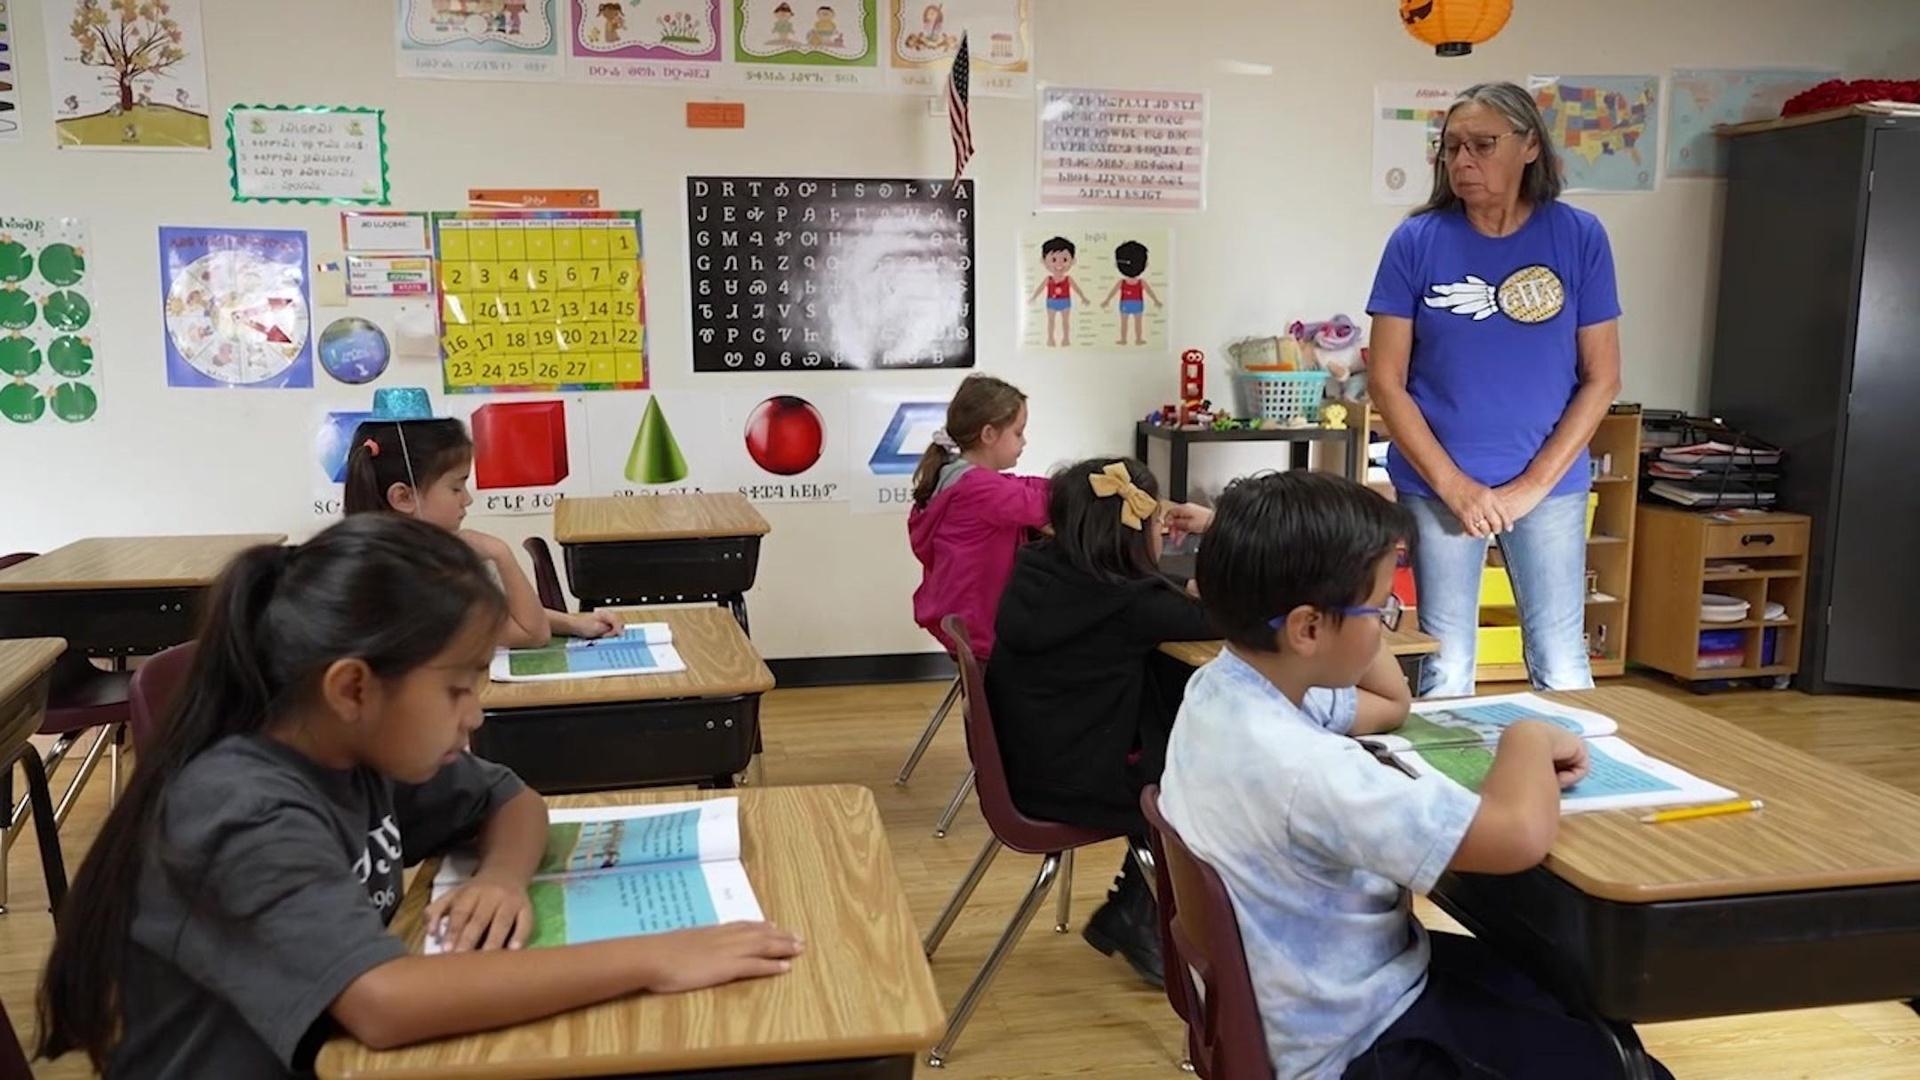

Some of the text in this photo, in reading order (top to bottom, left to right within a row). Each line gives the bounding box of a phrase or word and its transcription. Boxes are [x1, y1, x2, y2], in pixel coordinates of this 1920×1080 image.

[696, 182, 968, 198] Ꭰ Ꭱ Ꭲ Ꭳ Ꭴ Ꭵ Ꭶ Ꭷ Ꭸ Ꭹ Ꭺ
[698, 207, 707, 221] Ꭻ
[724, 207, 735, 221] Ꭼ
[747, 207, 764, 221] Ꭽ
[778, 207, 787, 222] Ꭾ
[803, 208, 815, 221] Ꭿ
[956, 208, 968, 223] Ꮅ
[620, 236, 628, 249] 1
[697, 231, 709, 246] Ꮆ
[722, 232, 737, 245] Ꮇ
[750, 232, 762, 246] Ꮈ
[775, 232, 791, 246] Ꮉ
[697, 256, 710, 270] Ꮐ
[724, 256, 737, 270] Ꮑ
[751, 256, 763, 270] Ꮒ
[778, 256, 788, 270] Ꮓ
[804, 256, 815, 270] Ꮔ
[453, 267, 628, 284] 2 3 4 5 6 7 8
[700, 280, 710, 294] Ꮛ
[726, 280, 737, 294] Ꮜ
[749, 280, 767, 294] Ꮝ
[779, 280, 788, 294] Ꮞ
[806, 280, 816, 293] Ꮟ
[480, 299, 634, 318] 10 11 12 13 14 15
[699, 304, 712, 318] Ꮦ
[726, 304, 738, 318] Ꮧ
[753, 304, 764, 318] Ꮨ
[779, 304, 790, 317] Ꮩ
[807, 304, 816, 317] Ꮪ
[447, 329, 636, 354] 16 17 18 19 20 21 22
[700, 328, 714, 342] Ꮱ
[728, 328, 738, 342] Ꮲ
[753, 328, 764, 342] Ꮳ
[778, 328, 792, 341] Ꮴ
[805, 328, 818, 341] Ꮵ
[725, 352, 742, 366] Ꮼ
[755, 352, 765, 366] Ꮽ
[781, 352, 791, 366] Ꮾ
[803, 351, 820, 365] Ꮿ
[452, 362, 586, 378] 23 24 25 26 27
